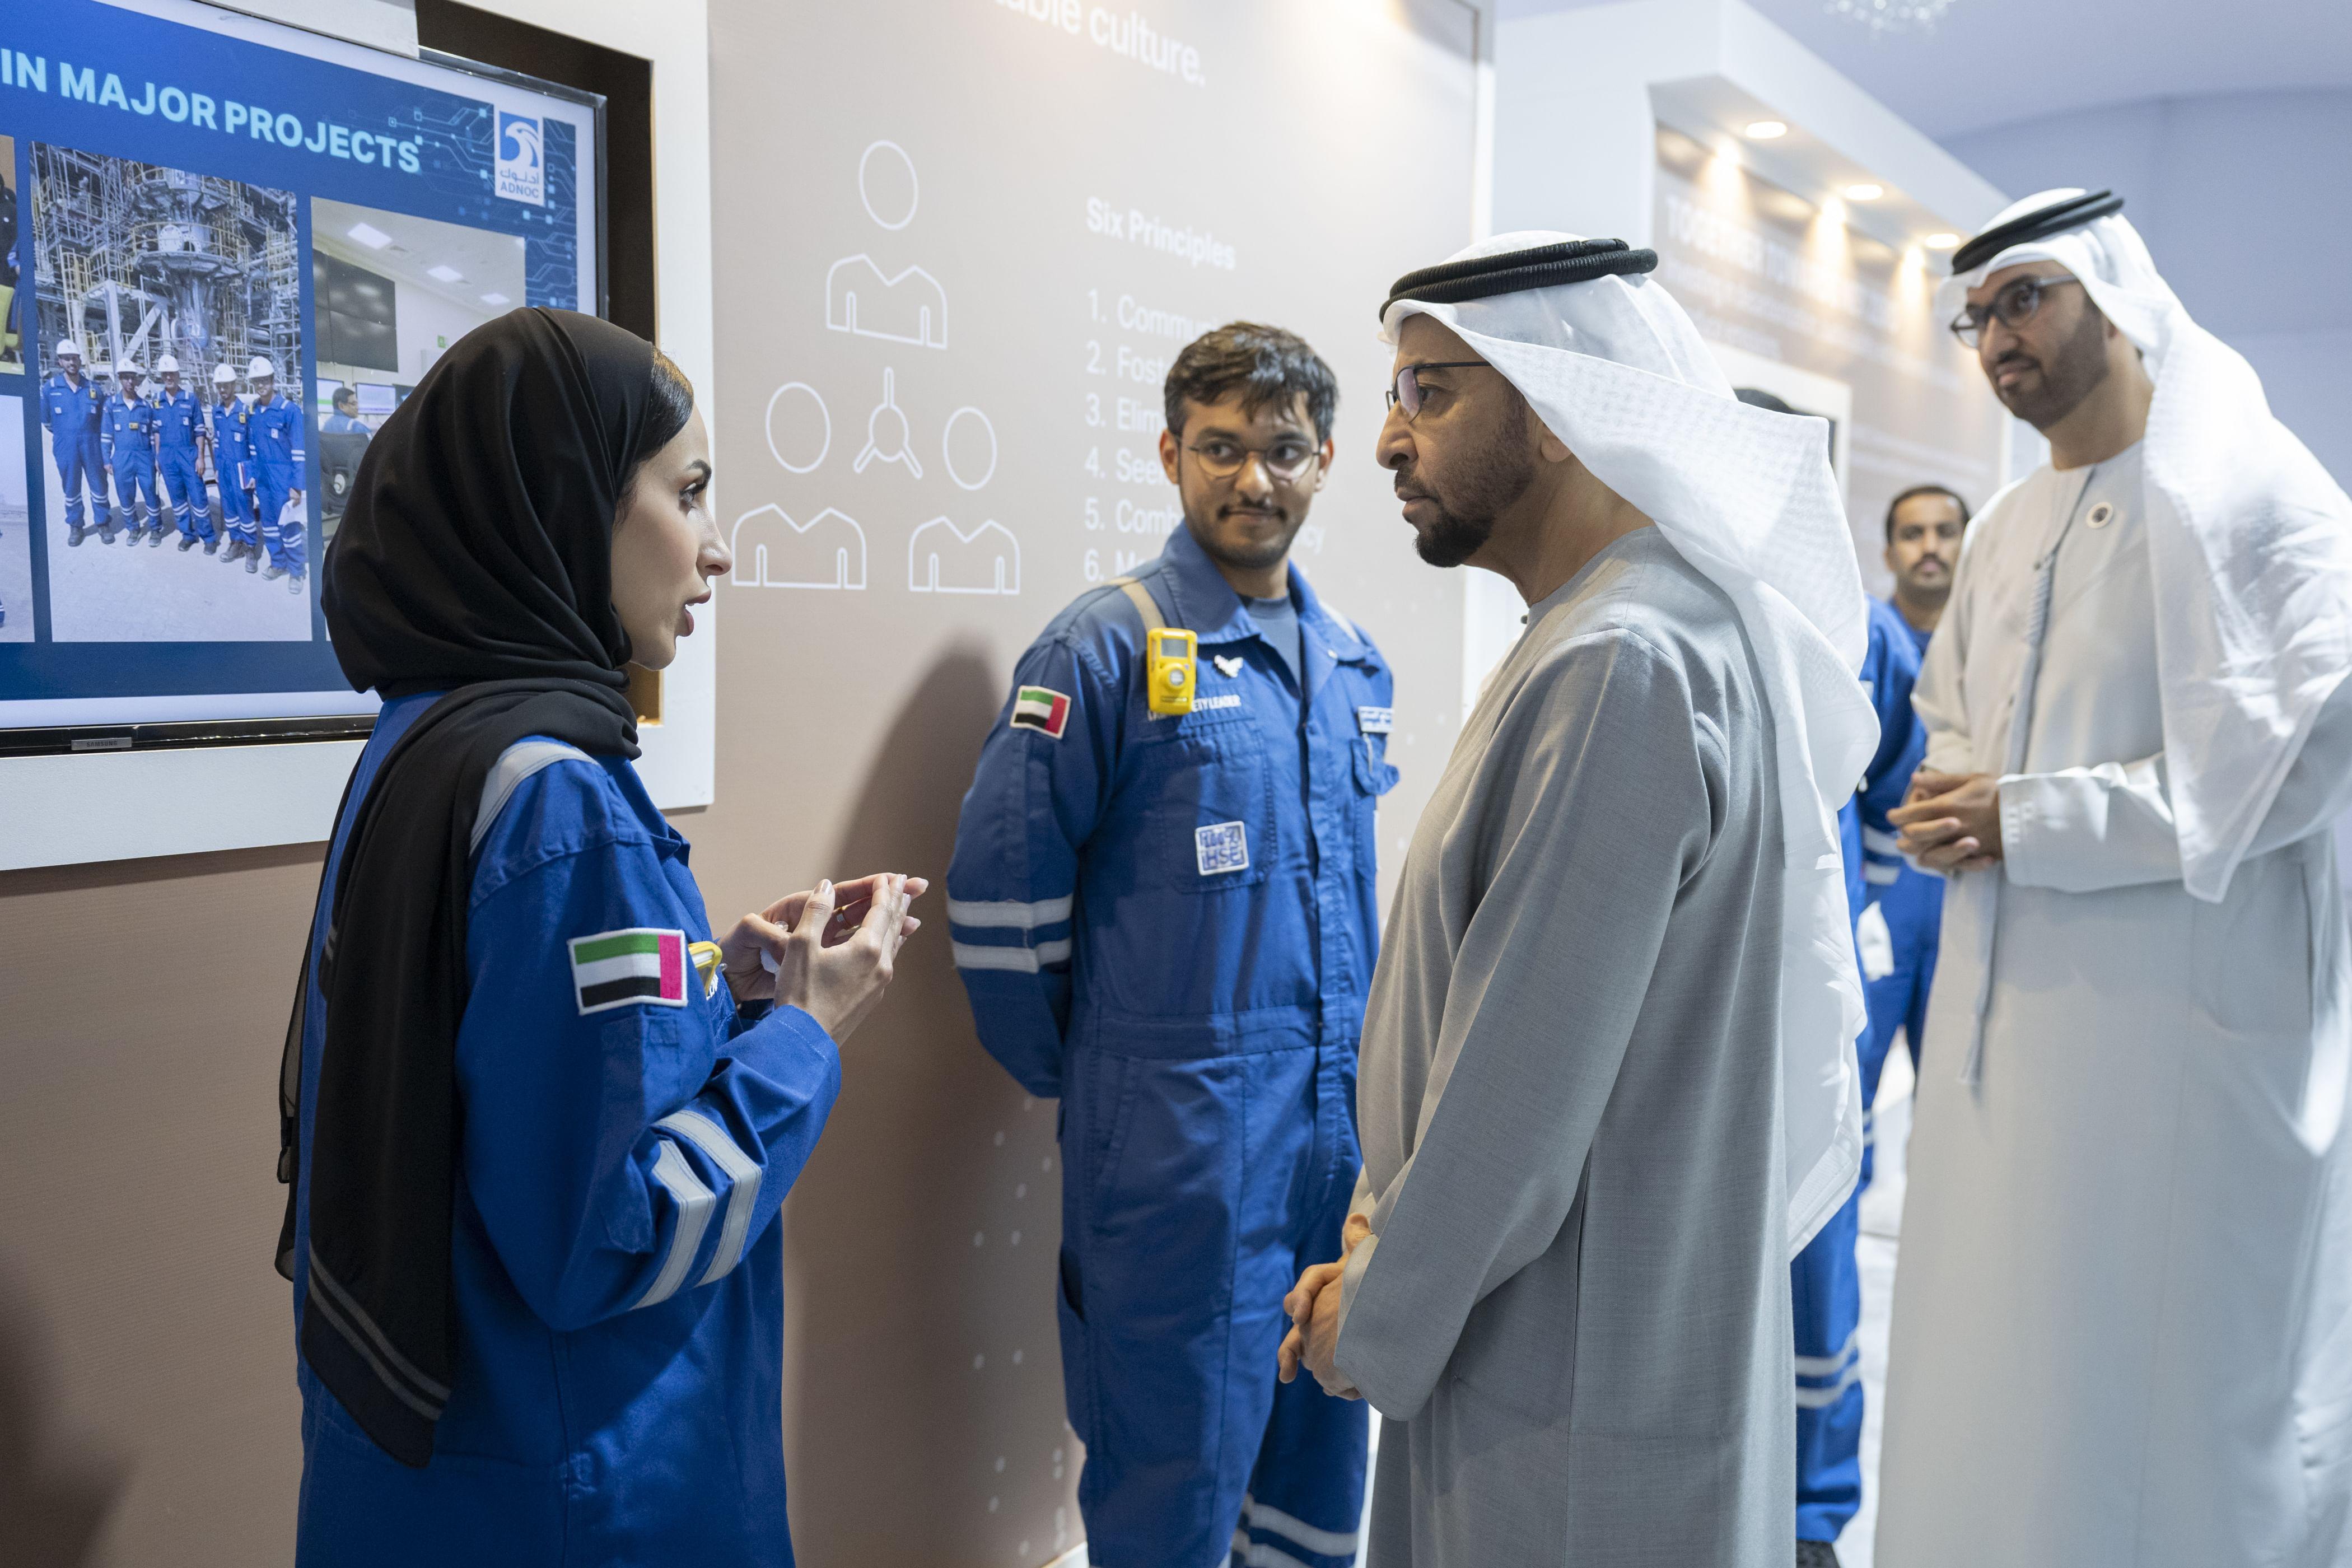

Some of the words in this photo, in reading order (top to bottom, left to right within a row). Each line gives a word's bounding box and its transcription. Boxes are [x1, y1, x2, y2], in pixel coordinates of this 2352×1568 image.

[1089, 6, 1206, 88] culture.
[1, 48, 47, 92] IN
[60, 62, 218, 130] MAJOR
[224, 100, 421, 174] PROJECTS
[501, 181, 539, 198] ADNOC
[1086, 196, 1124, 240] Six
[1129, 208, 1236, 270] Principles
[1088, 288, 1107, 324] 1.
[1086, 339, 1107, 376] 2.
[1085, 393, 1107, 428] 3.
[1084, 446, 1107, 479] 4.
[1084, 496, 1106, 531] 5.
[1084, 548, 1105, 582] 6.
